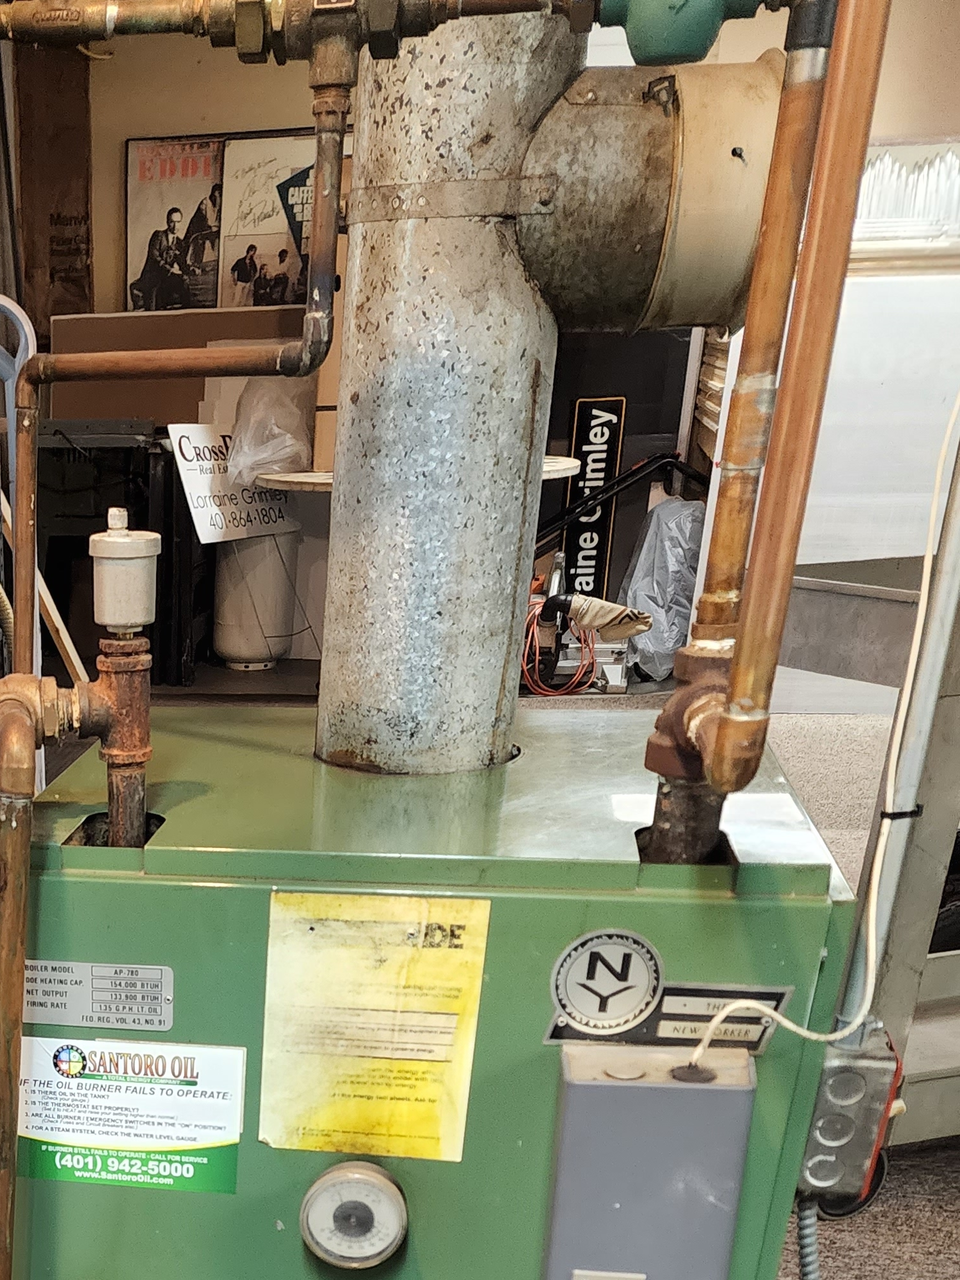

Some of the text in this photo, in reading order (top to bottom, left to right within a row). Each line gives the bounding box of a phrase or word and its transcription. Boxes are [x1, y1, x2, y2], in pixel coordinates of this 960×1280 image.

[199, 464, 215, 475] Real
[189, 490, 239, 509] Lorraine
[25, 964, 75, 974] BOILER MODEL
[40, 977, 68, 986] HEATING
[141, 982, 159, 990] BTUH
[26, 989, 68, 998] NET OUTPUT
[141, 994, 159, 1003] BTUH
[26, 1001, 67, 1010] FIRING RATE
[707, 1027, 750, 1037] ORKER
[88, 1050, 199, 1079] SANTORO OIL
[19, 1078, 30, 1087] IF
[32, 1079, 53, 1089] THE
[56, 1080, 73, 1090] OIL
[76, 1082, 122, 1093] BURNER
[125, 1085, 156, 1096] FAILS
[159, 1087, 174, 1097] TO
[51, 1102, 90, 1110] THERMOSTAT
[104, 1105, 140, 1113] PROPERLY?
[86, 1116, 123, 1124] EMERGENCY
[124, 1119, 155, 1127] SWITCHES
[194, 1123, 227, 1131] POSITION?
[48, 1145, 73, 1153] BURNER
[91, 1148, 108, 1156] FAILS
[118, 1150, 146, 1159] OPERATE
[167, 1154, 181, 1162] FOR
[182, 1155, 208, 1164] SERVICE
[55, 1152, 194, 1178] (401) 942-5000
[74, 1170, 174, 1185] www.SantoroOil.com
